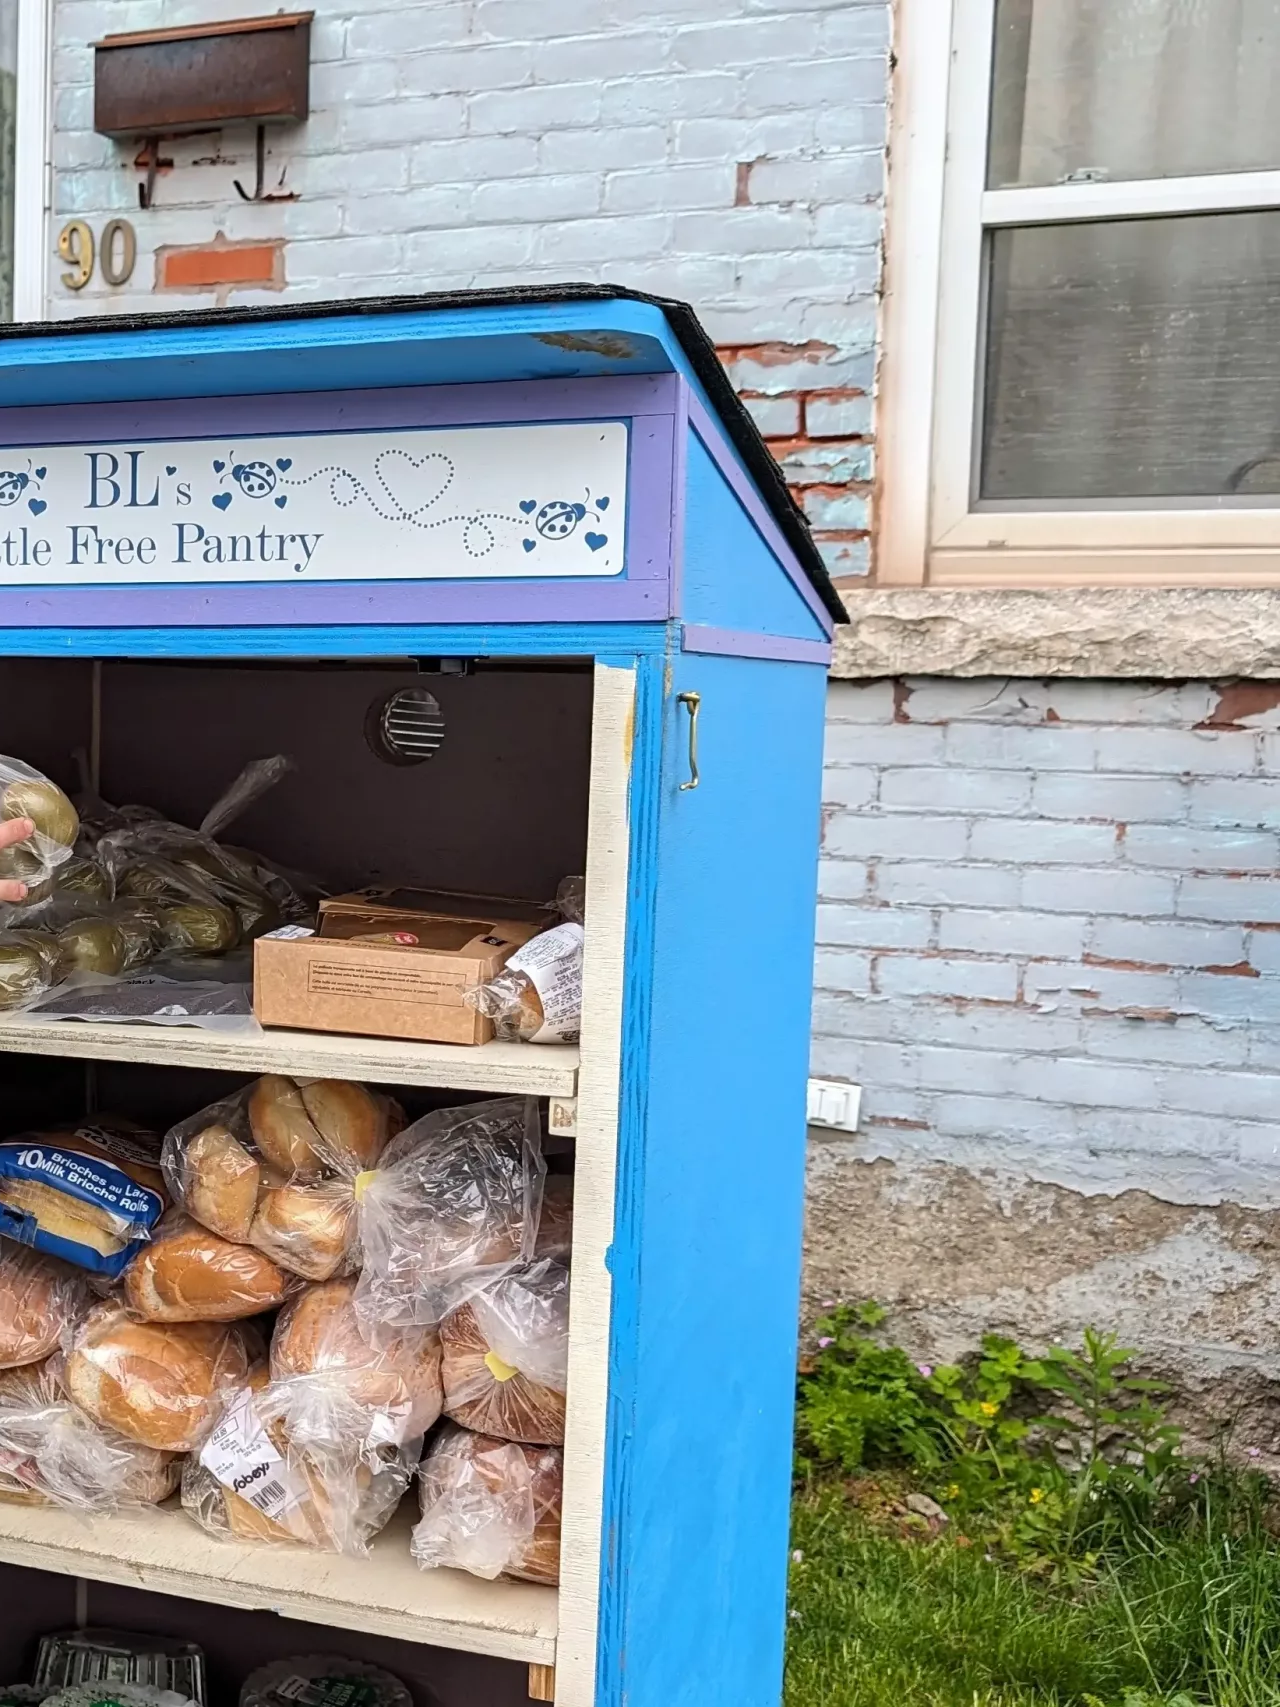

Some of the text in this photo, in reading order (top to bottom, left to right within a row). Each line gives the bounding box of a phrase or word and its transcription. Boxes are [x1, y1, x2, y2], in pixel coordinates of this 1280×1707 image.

[58, 218, 137, 291] 90
[66, 525, 157, 565] Free
[171, 522, 324, 573] Pantry
[16, 1149, 44, 1169] 10
[51, 1152, 107, 1186] Brioches
[109, 1184, 122, 1195] au
[38, 1158, 150, 1213] Milk Brioche Rolls
[233, 1461, 270, 1493] Sobeys
